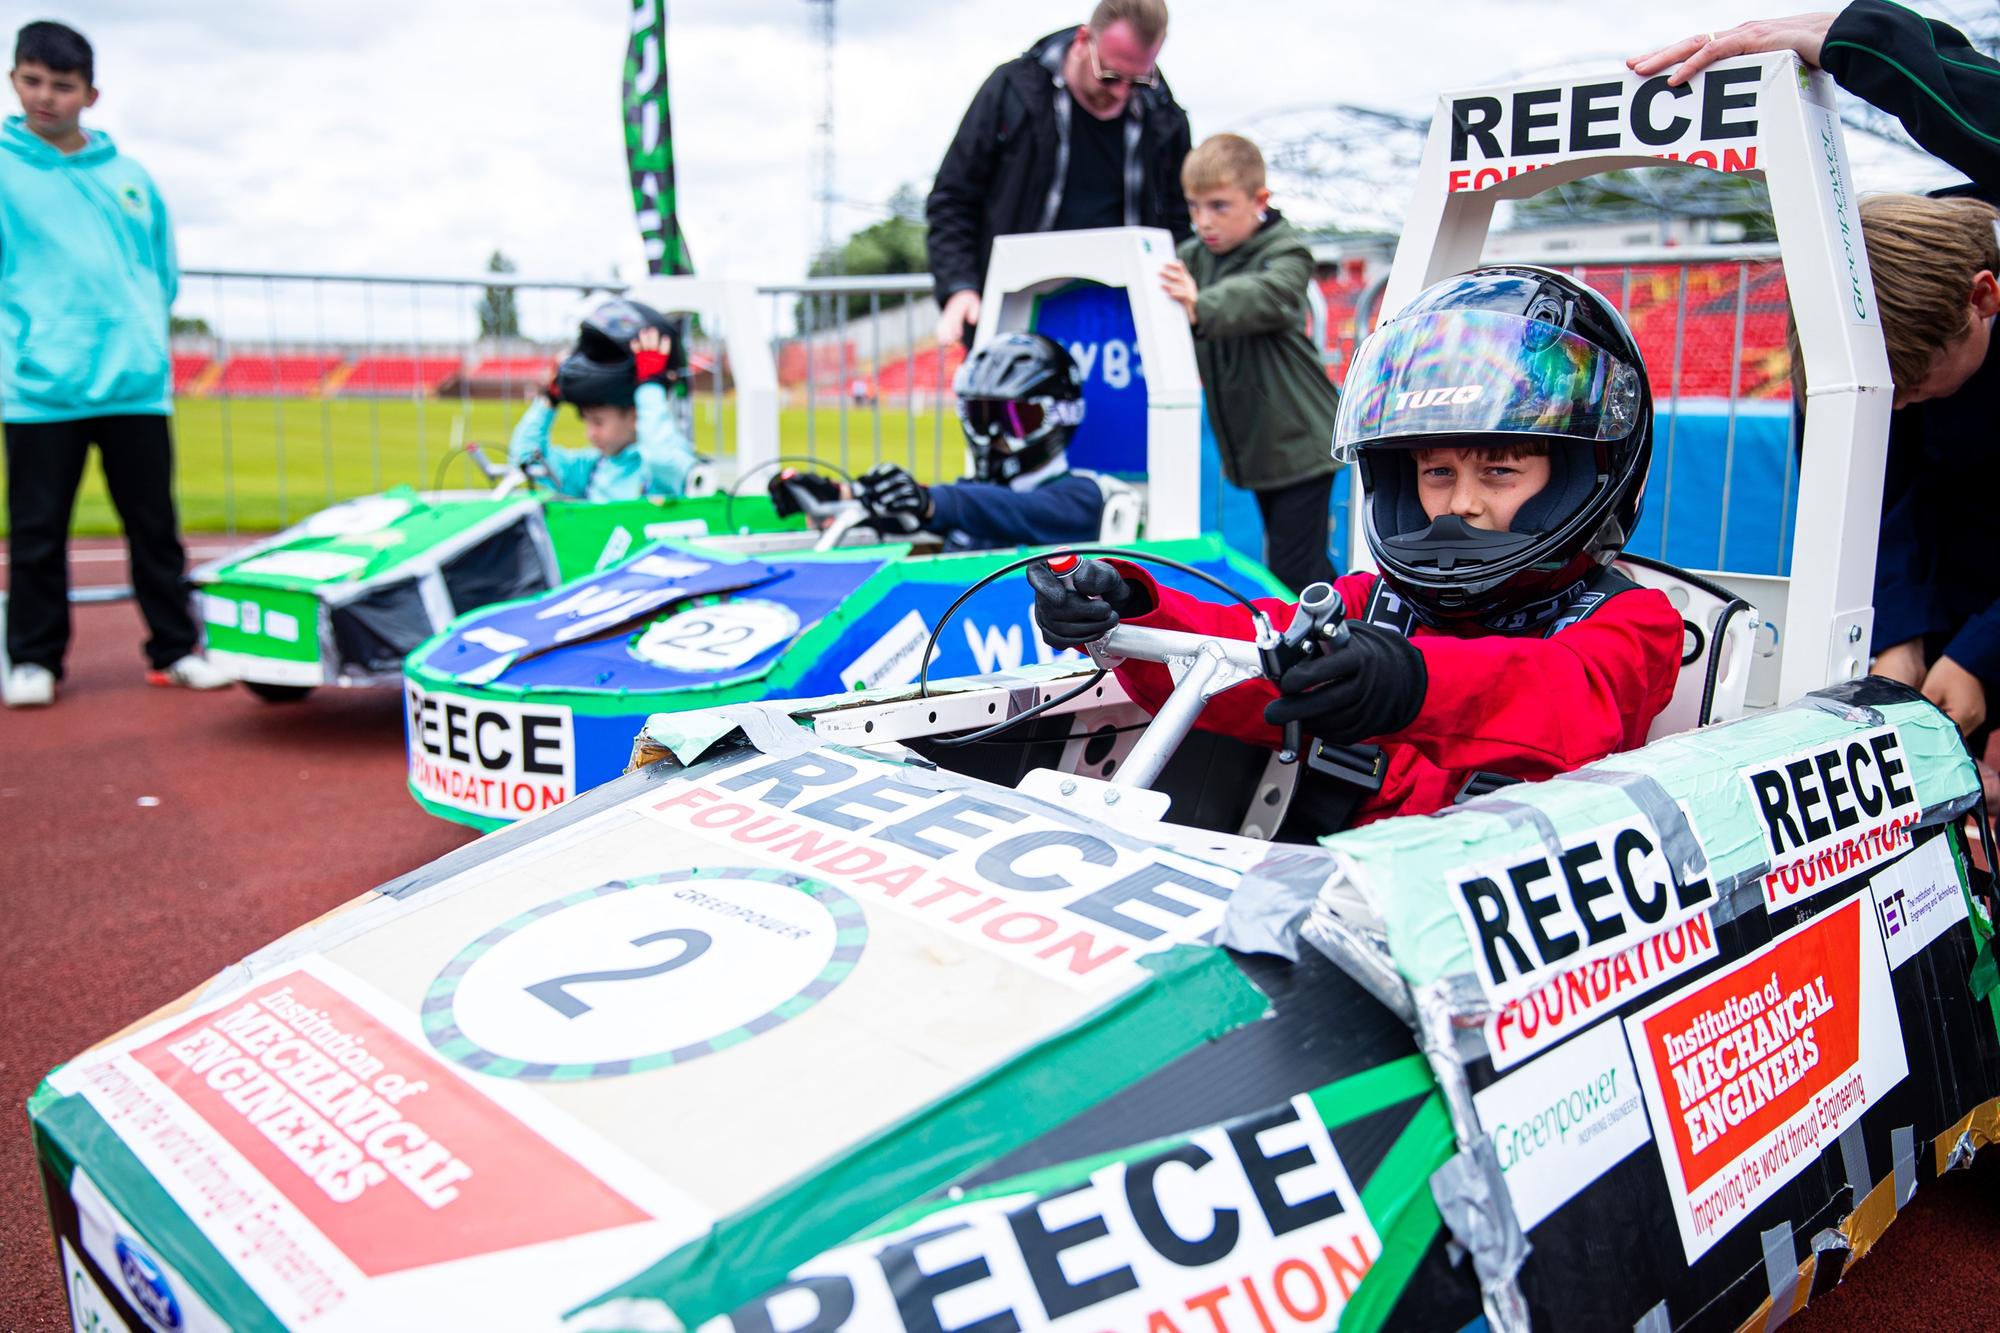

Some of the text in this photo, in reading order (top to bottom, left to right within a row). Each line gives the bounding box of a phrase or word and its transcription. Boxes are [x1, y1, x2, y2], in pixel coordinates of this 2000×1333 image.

[1450, 66, 1762, 162] REECE
[1825, 113, 1848, 210] INSPIRING ENGINEERS
[1821, 129, 1866, 320] Greenpower
[1395, 384, 1483, 411] TUZO
[658, 620, 754, 655] 22
[715, 751, 1233, 942] REECE
[1750, 732, 1914, 856] REECE
[651, 787, 1129, 975] FOUNDATION
[1766, 812, 1918, 902] FOUNDATION
[673, 889, 811, 939] GREENPOWER
[1878, 889, 1907, 939] IET
[523, 928, 712, 1019] 2
[1663, 971, 1782, 1066] Institution of
[259, 986, 429, 1105] Institution of
[1671, 975, 1834, 1111] MECHANICAL
[1684, 1027, 1819, 1156] ENGINEERS
[166, 1027, 388, 1203] ENGINEERS
[213, 1002, 472, 1209] MECHANICAL
[1494, 1068, 1617, 1172] Greenpower
[1689, 1072, 1865, 1237] Improving the world throug Engineering
